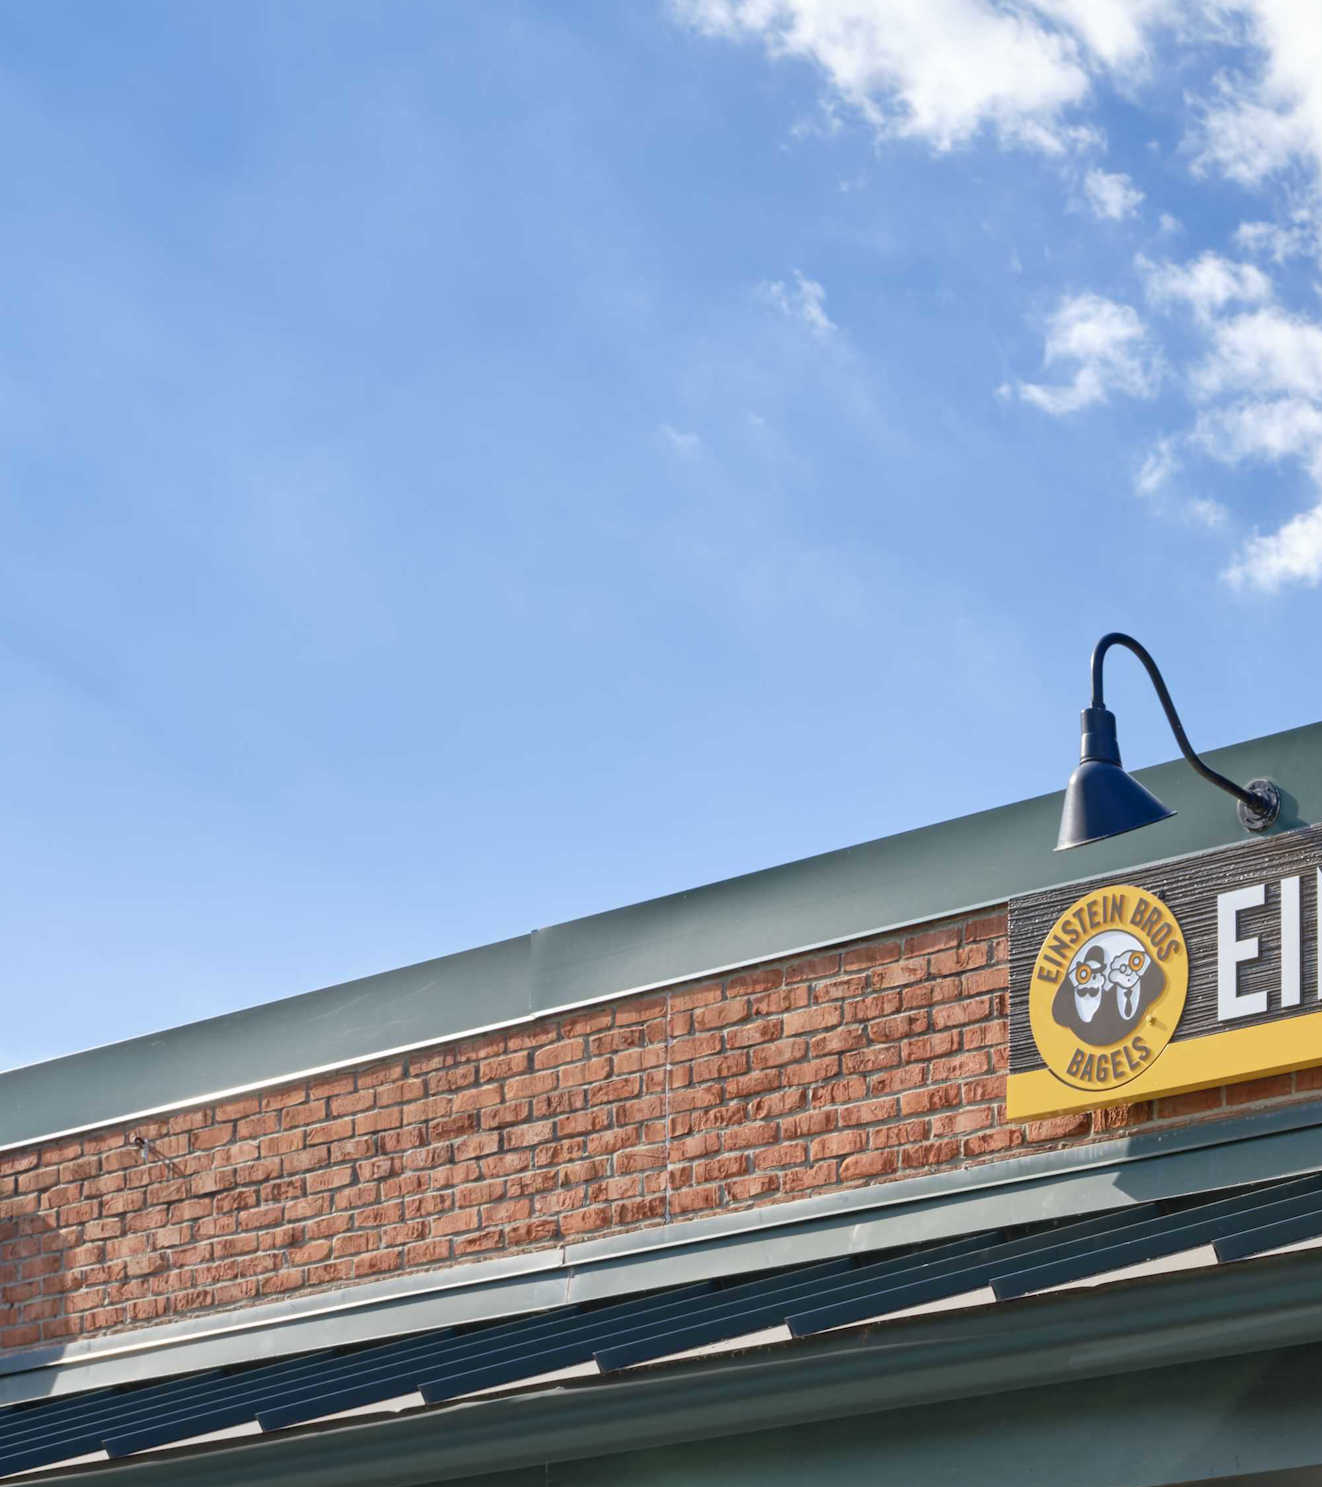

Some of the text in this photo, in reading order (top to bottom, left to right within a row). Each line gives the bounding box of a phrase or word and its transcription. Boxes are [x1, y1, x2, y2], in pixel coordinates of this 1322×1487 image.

[1037, 893, 1182, 984] EINSTEIN BROS
[1066, 1036, 1153, 1083] BAGELS
